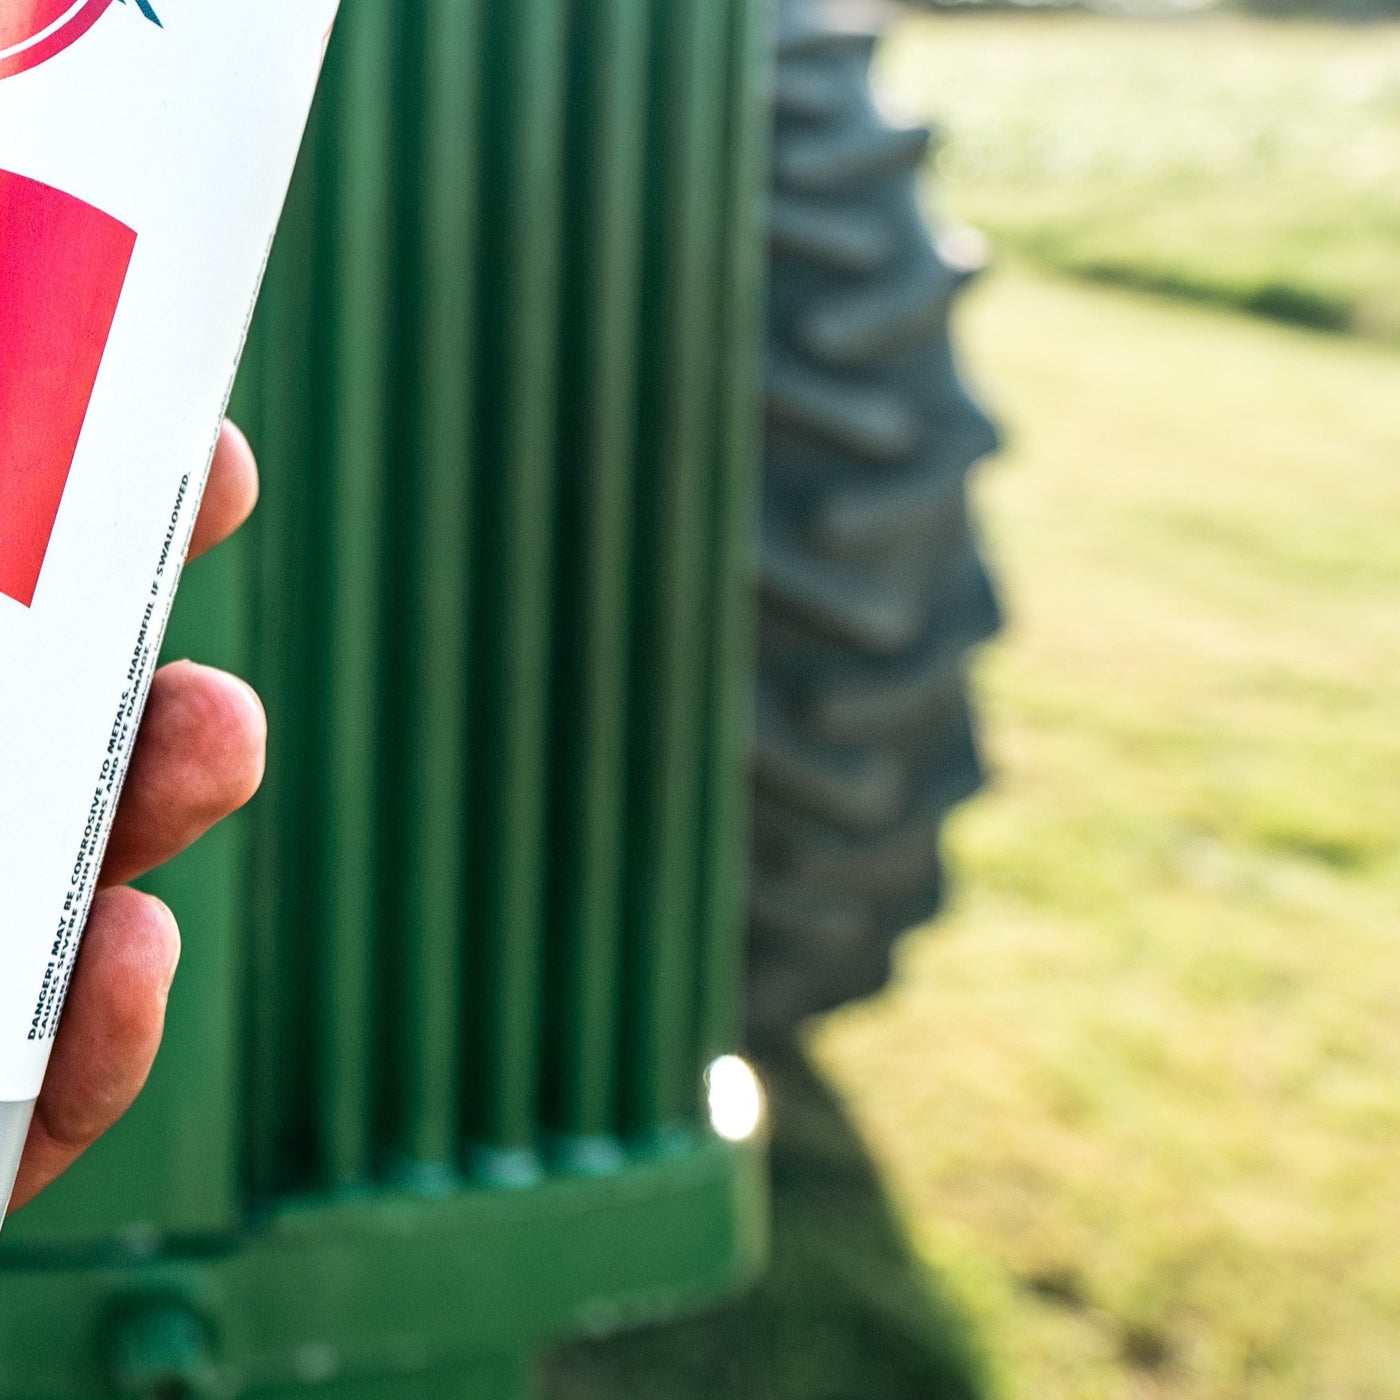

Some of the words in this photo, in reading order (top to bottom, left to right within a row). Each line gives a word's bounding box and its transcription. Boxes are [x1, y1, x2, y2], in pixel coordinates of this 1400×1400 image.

[37, 974, 59, 1039] CAUSES
[56, 908, 78, 969] SEVERE
[75, 861, 90, 902] SKIN
[87, 799, 107, 855] BURNS
[104, 756, 119, 792] AND
[116, 723, 128, 751] EYE
[50, 916, 67, 956] MAY
[63, 890, 74, 911] BE
[69, 786, 103, 886] CORROSIVE
[98, 758, 110, 782] TO
[106, 685, 131, 754] METALS.
[126, 601, 154, 680] HARMFUL
[150, 581, 159, 595] IF
[155, 469, 190, 576] SWALLOWED.
